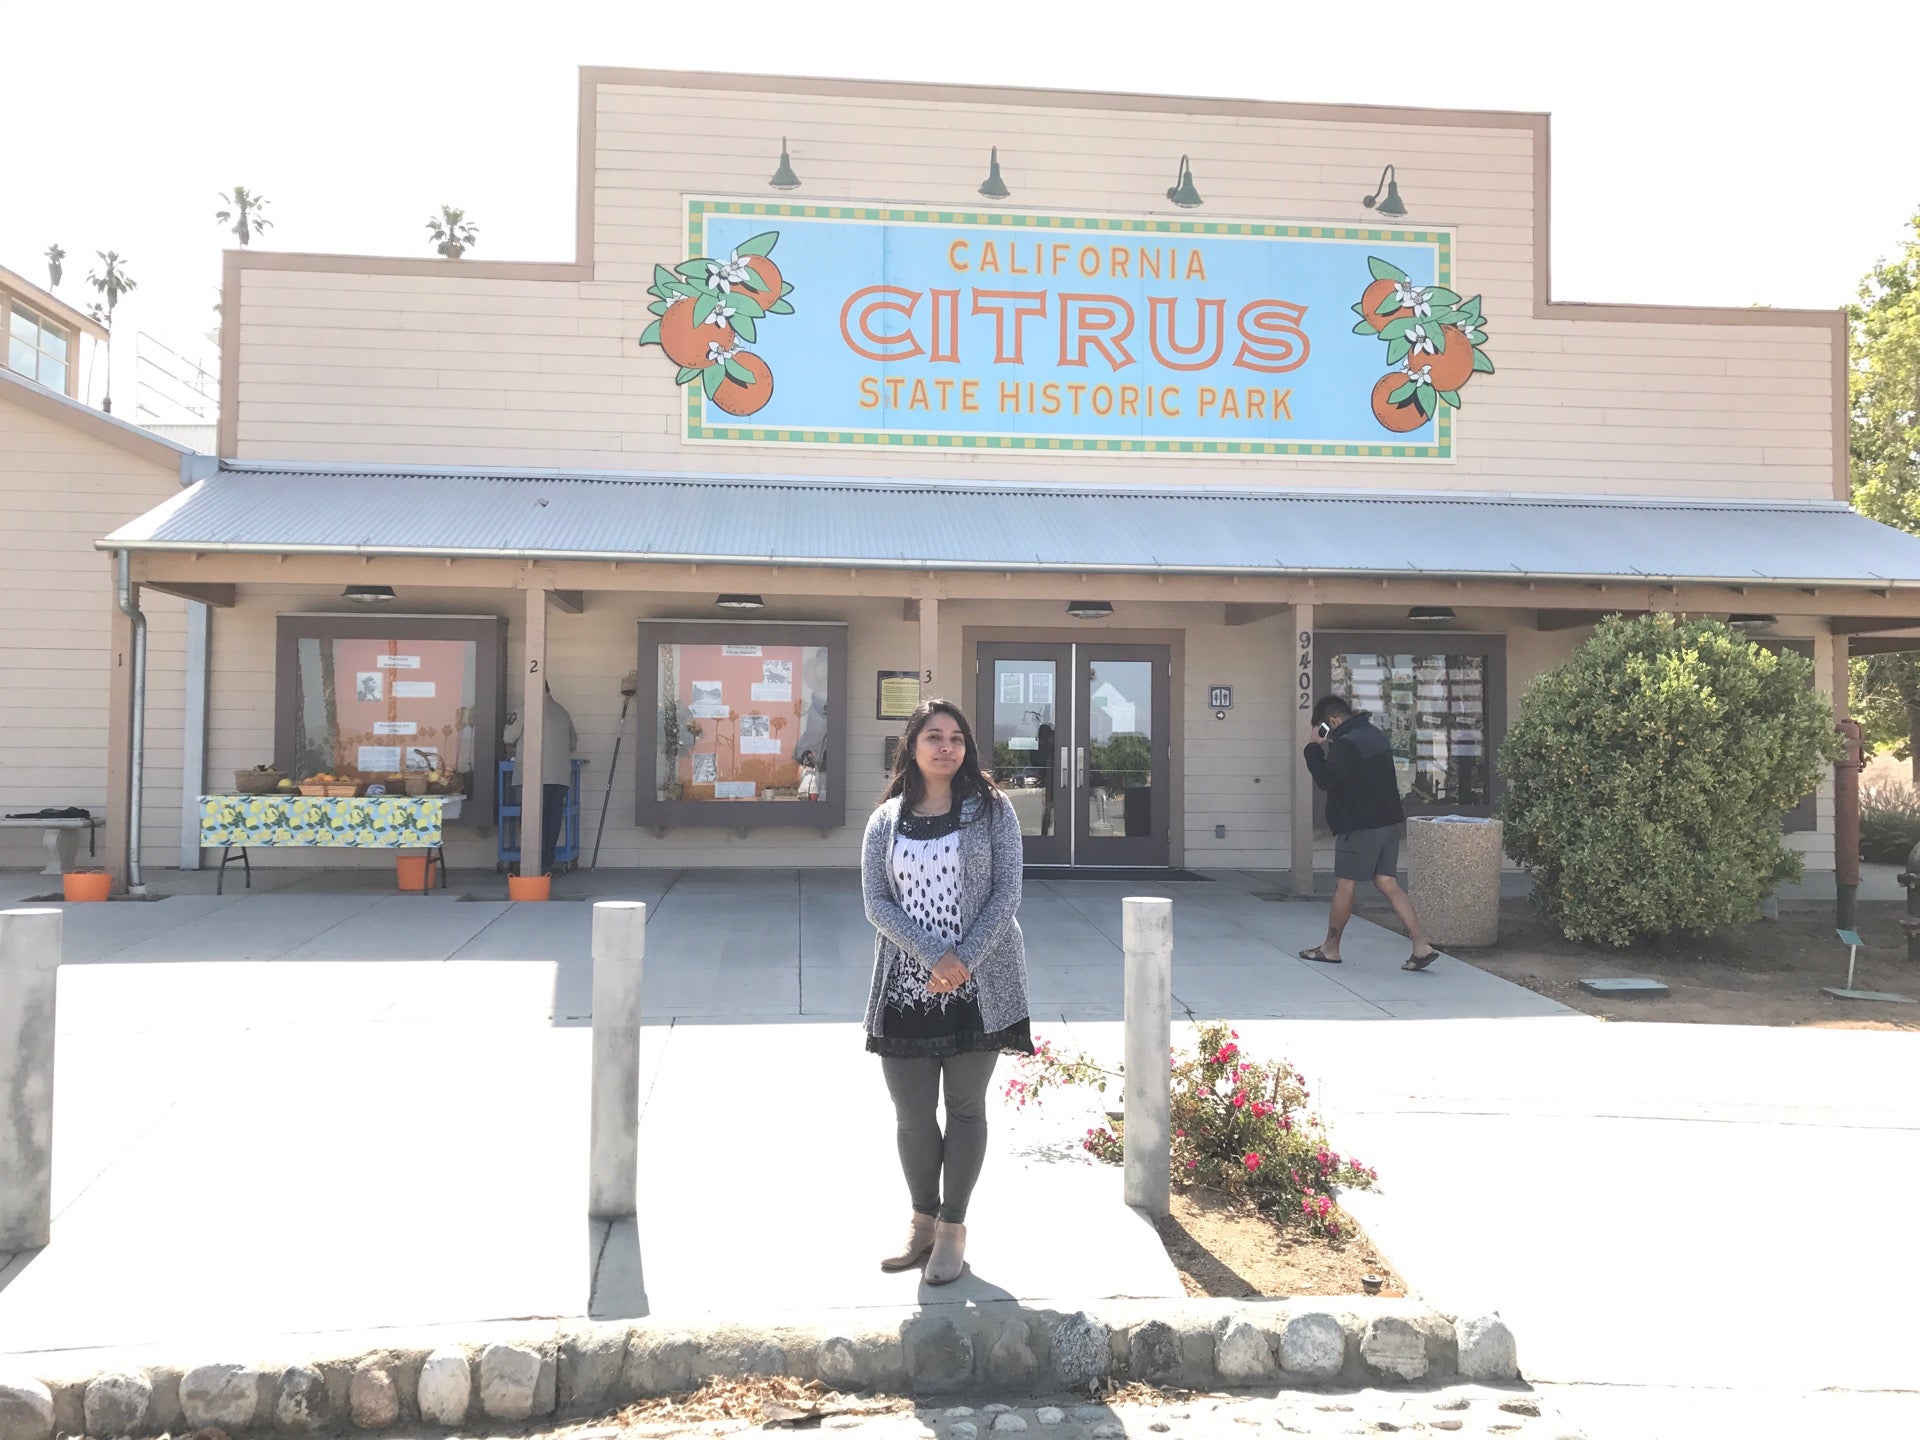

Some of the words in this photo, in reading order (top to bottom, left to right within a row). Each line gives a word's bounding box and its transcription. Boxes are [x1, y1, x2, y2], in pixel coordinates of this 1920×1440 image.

[948, 239, 1207, 281] CALIFORNIA
[839, 284, 1311, 374] CITRUS
[859, 376, 981, 412] STATE
[999, 381, 1182, 418] HISTORIC
[1198, 386, 1294, 421] PARK
[118, 652, 123, 667] 1
[530, 660, 538, 673] 2
[923, 669, 932, 683] 3
[1299, 631, 1311, 709] 9402
